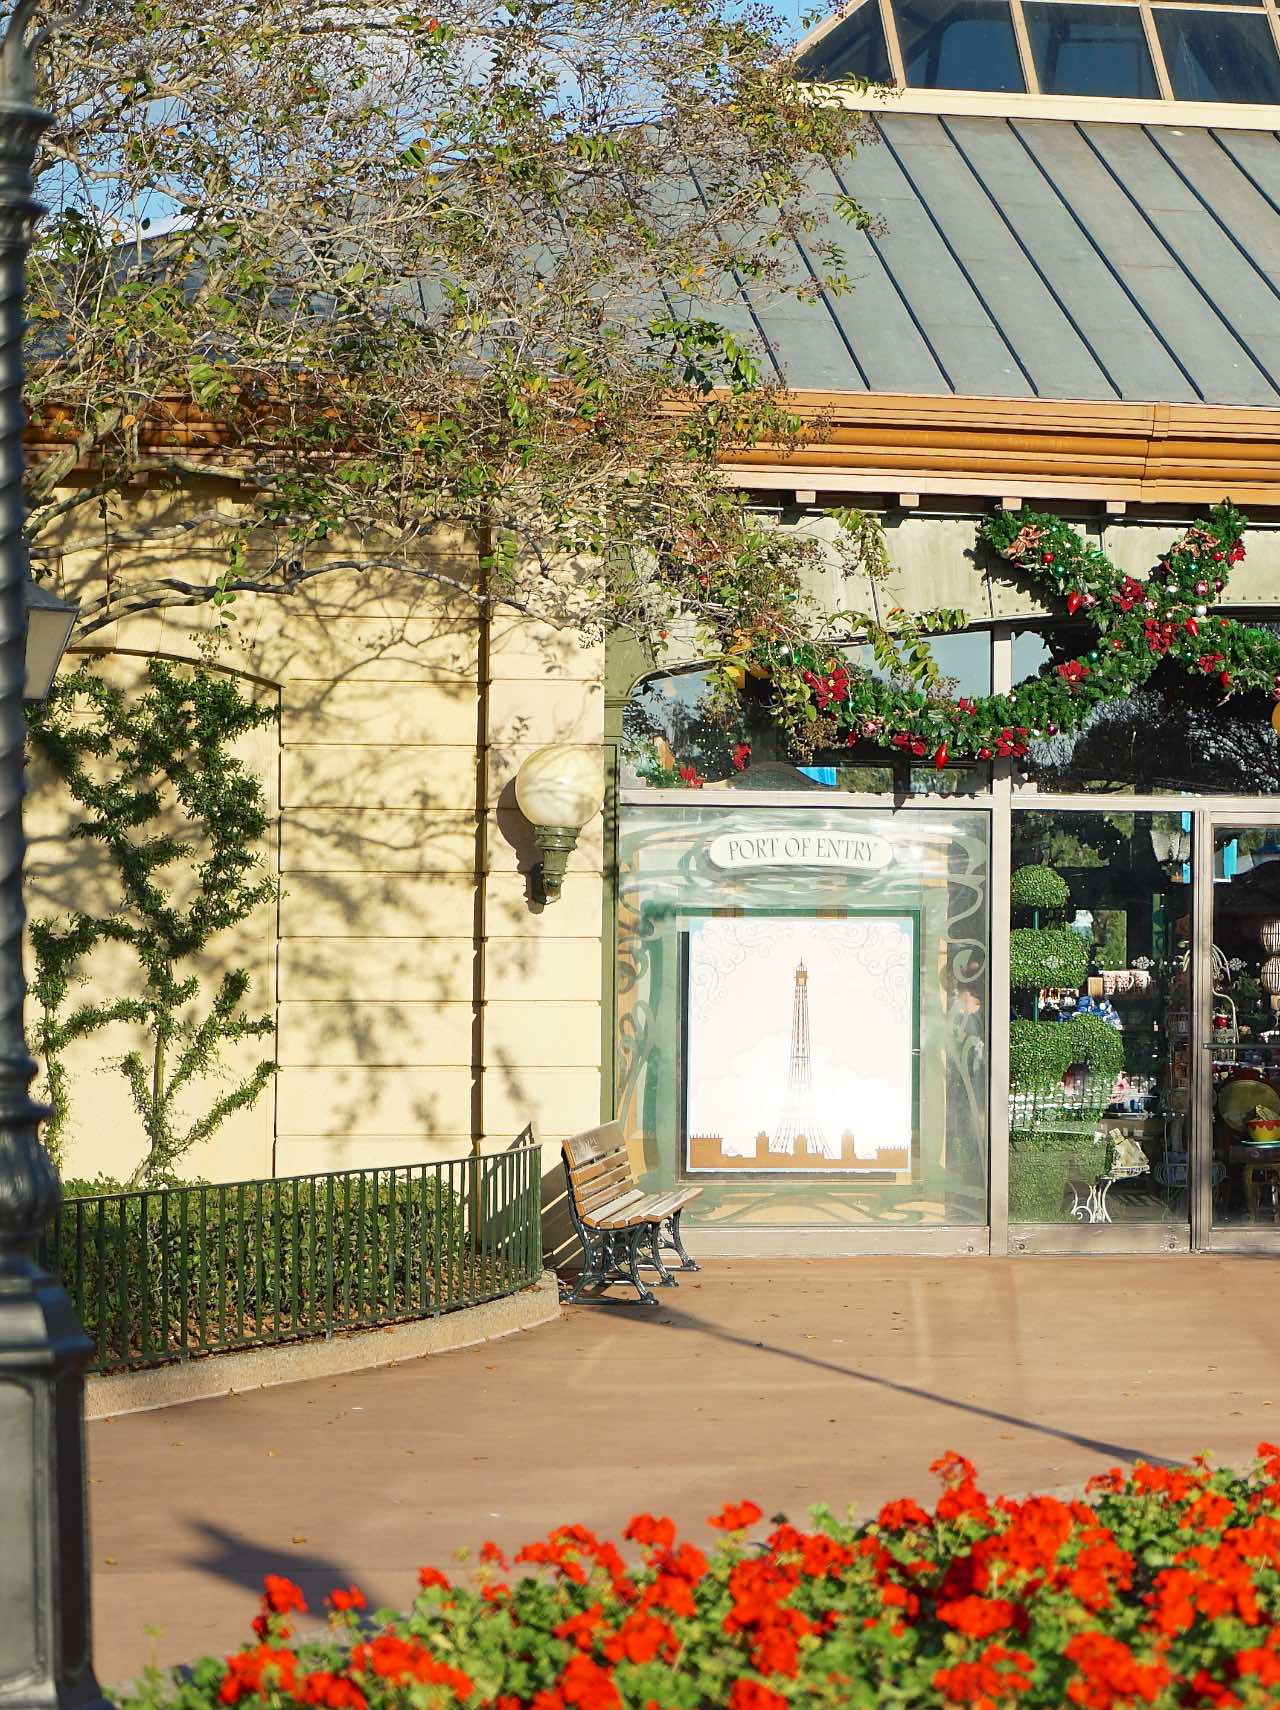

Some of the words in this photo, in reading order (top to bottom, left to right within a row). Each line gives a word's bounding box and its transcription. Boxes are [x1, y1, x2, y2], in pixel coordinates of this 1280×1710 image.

[728, 838, 778, 861] PORT
[784, 837, 811, 858] OF
[816, 838, 879, 862] ENTRY
